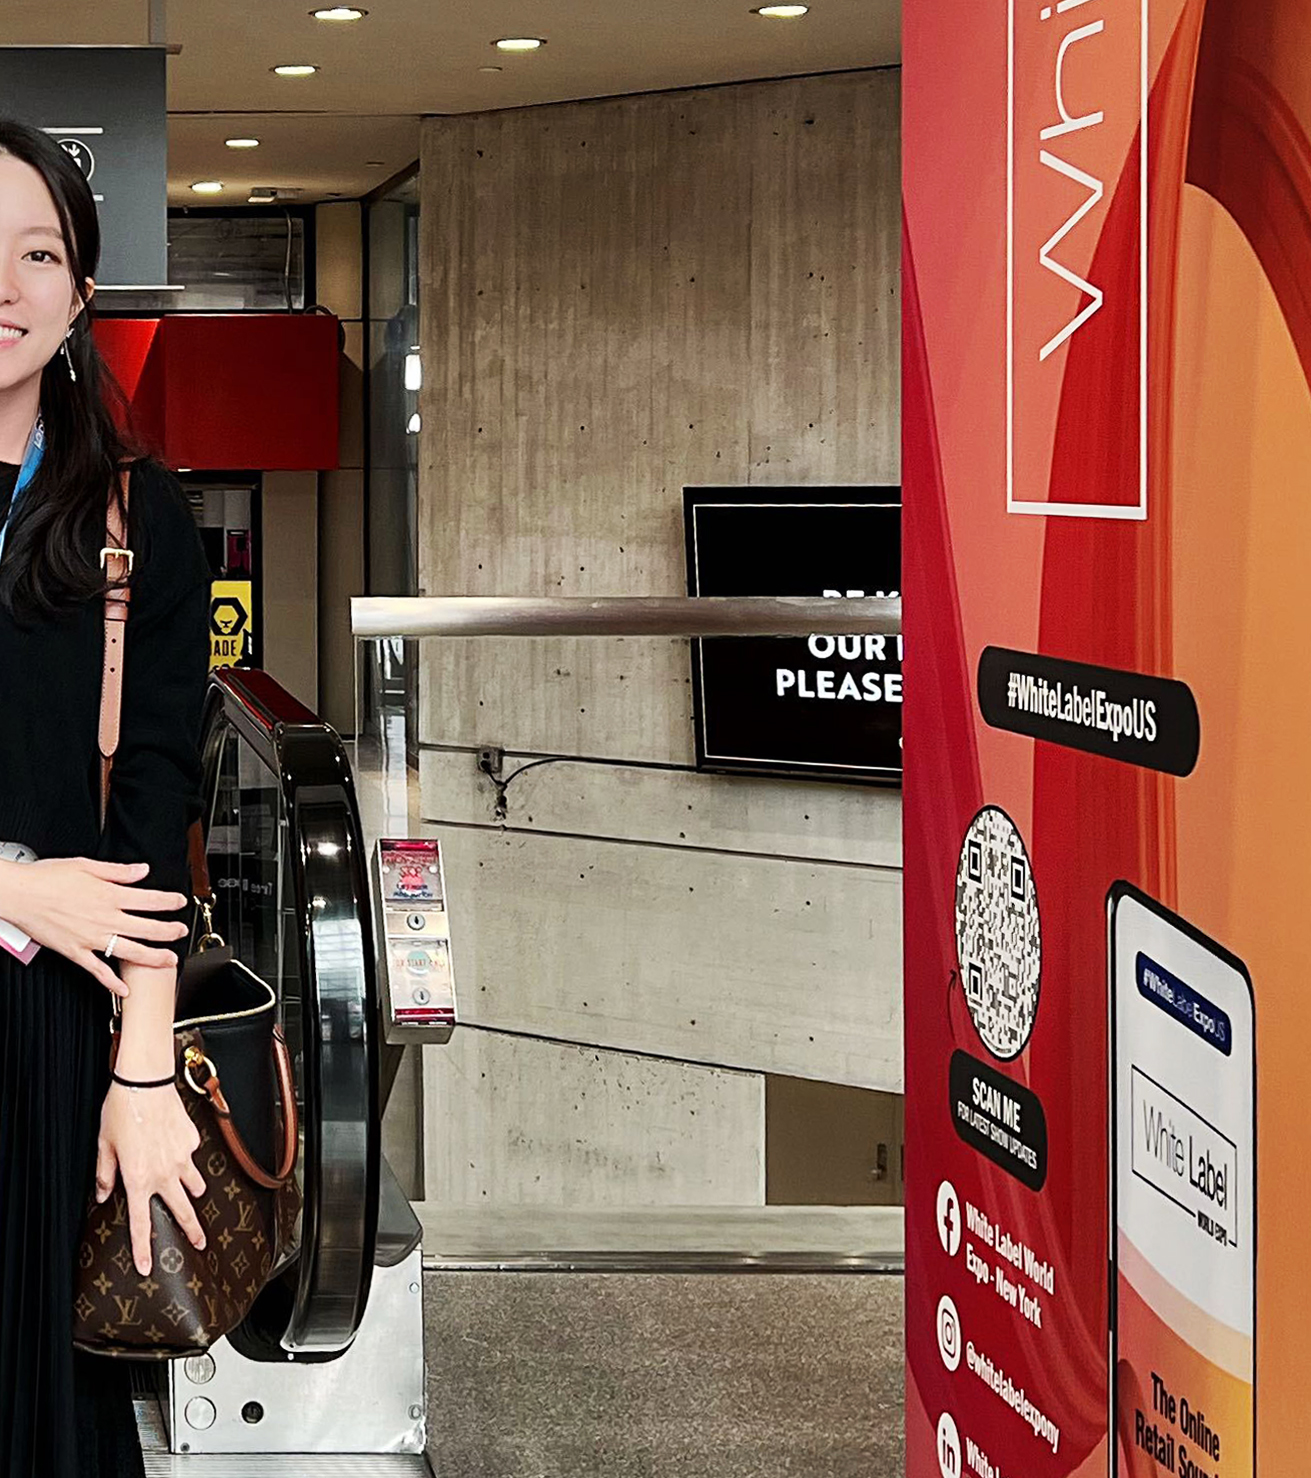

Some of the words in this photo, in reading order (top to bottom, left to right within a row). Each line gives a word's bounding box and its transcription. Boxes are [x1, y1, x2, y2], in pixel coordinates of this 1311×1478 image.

[776, 668, 903, 703] PLEASE
[807, 634, 887, 661] OUR
[1007, 672, 1157, 742] #WhiteLabelExpoUS
[972, 1077, 1001, 1120] SCAN
[1003, 1095, 1021, 1133] ME
[1143, 1099, 1185, 1177] White
[1189, 1135, 1227, 1211] Label
[966, 1201, 994, 1247] White
[995, 1223, 1023, 1270] Label
[1023, 1244, 1054, 1295] World
[966, 1242, 989, 1284] Expo
[995, 1265, 1017, 1308] New
[1017, 1283, 1042, 1329] York
[966, 1341, 1059, 1454] @whitelabelexpony
[1151, 1371, 1176, 1425] The
[1179, 1397, 1220, 1462] Online
[1135, 1408, 1175, 1474] Retail
